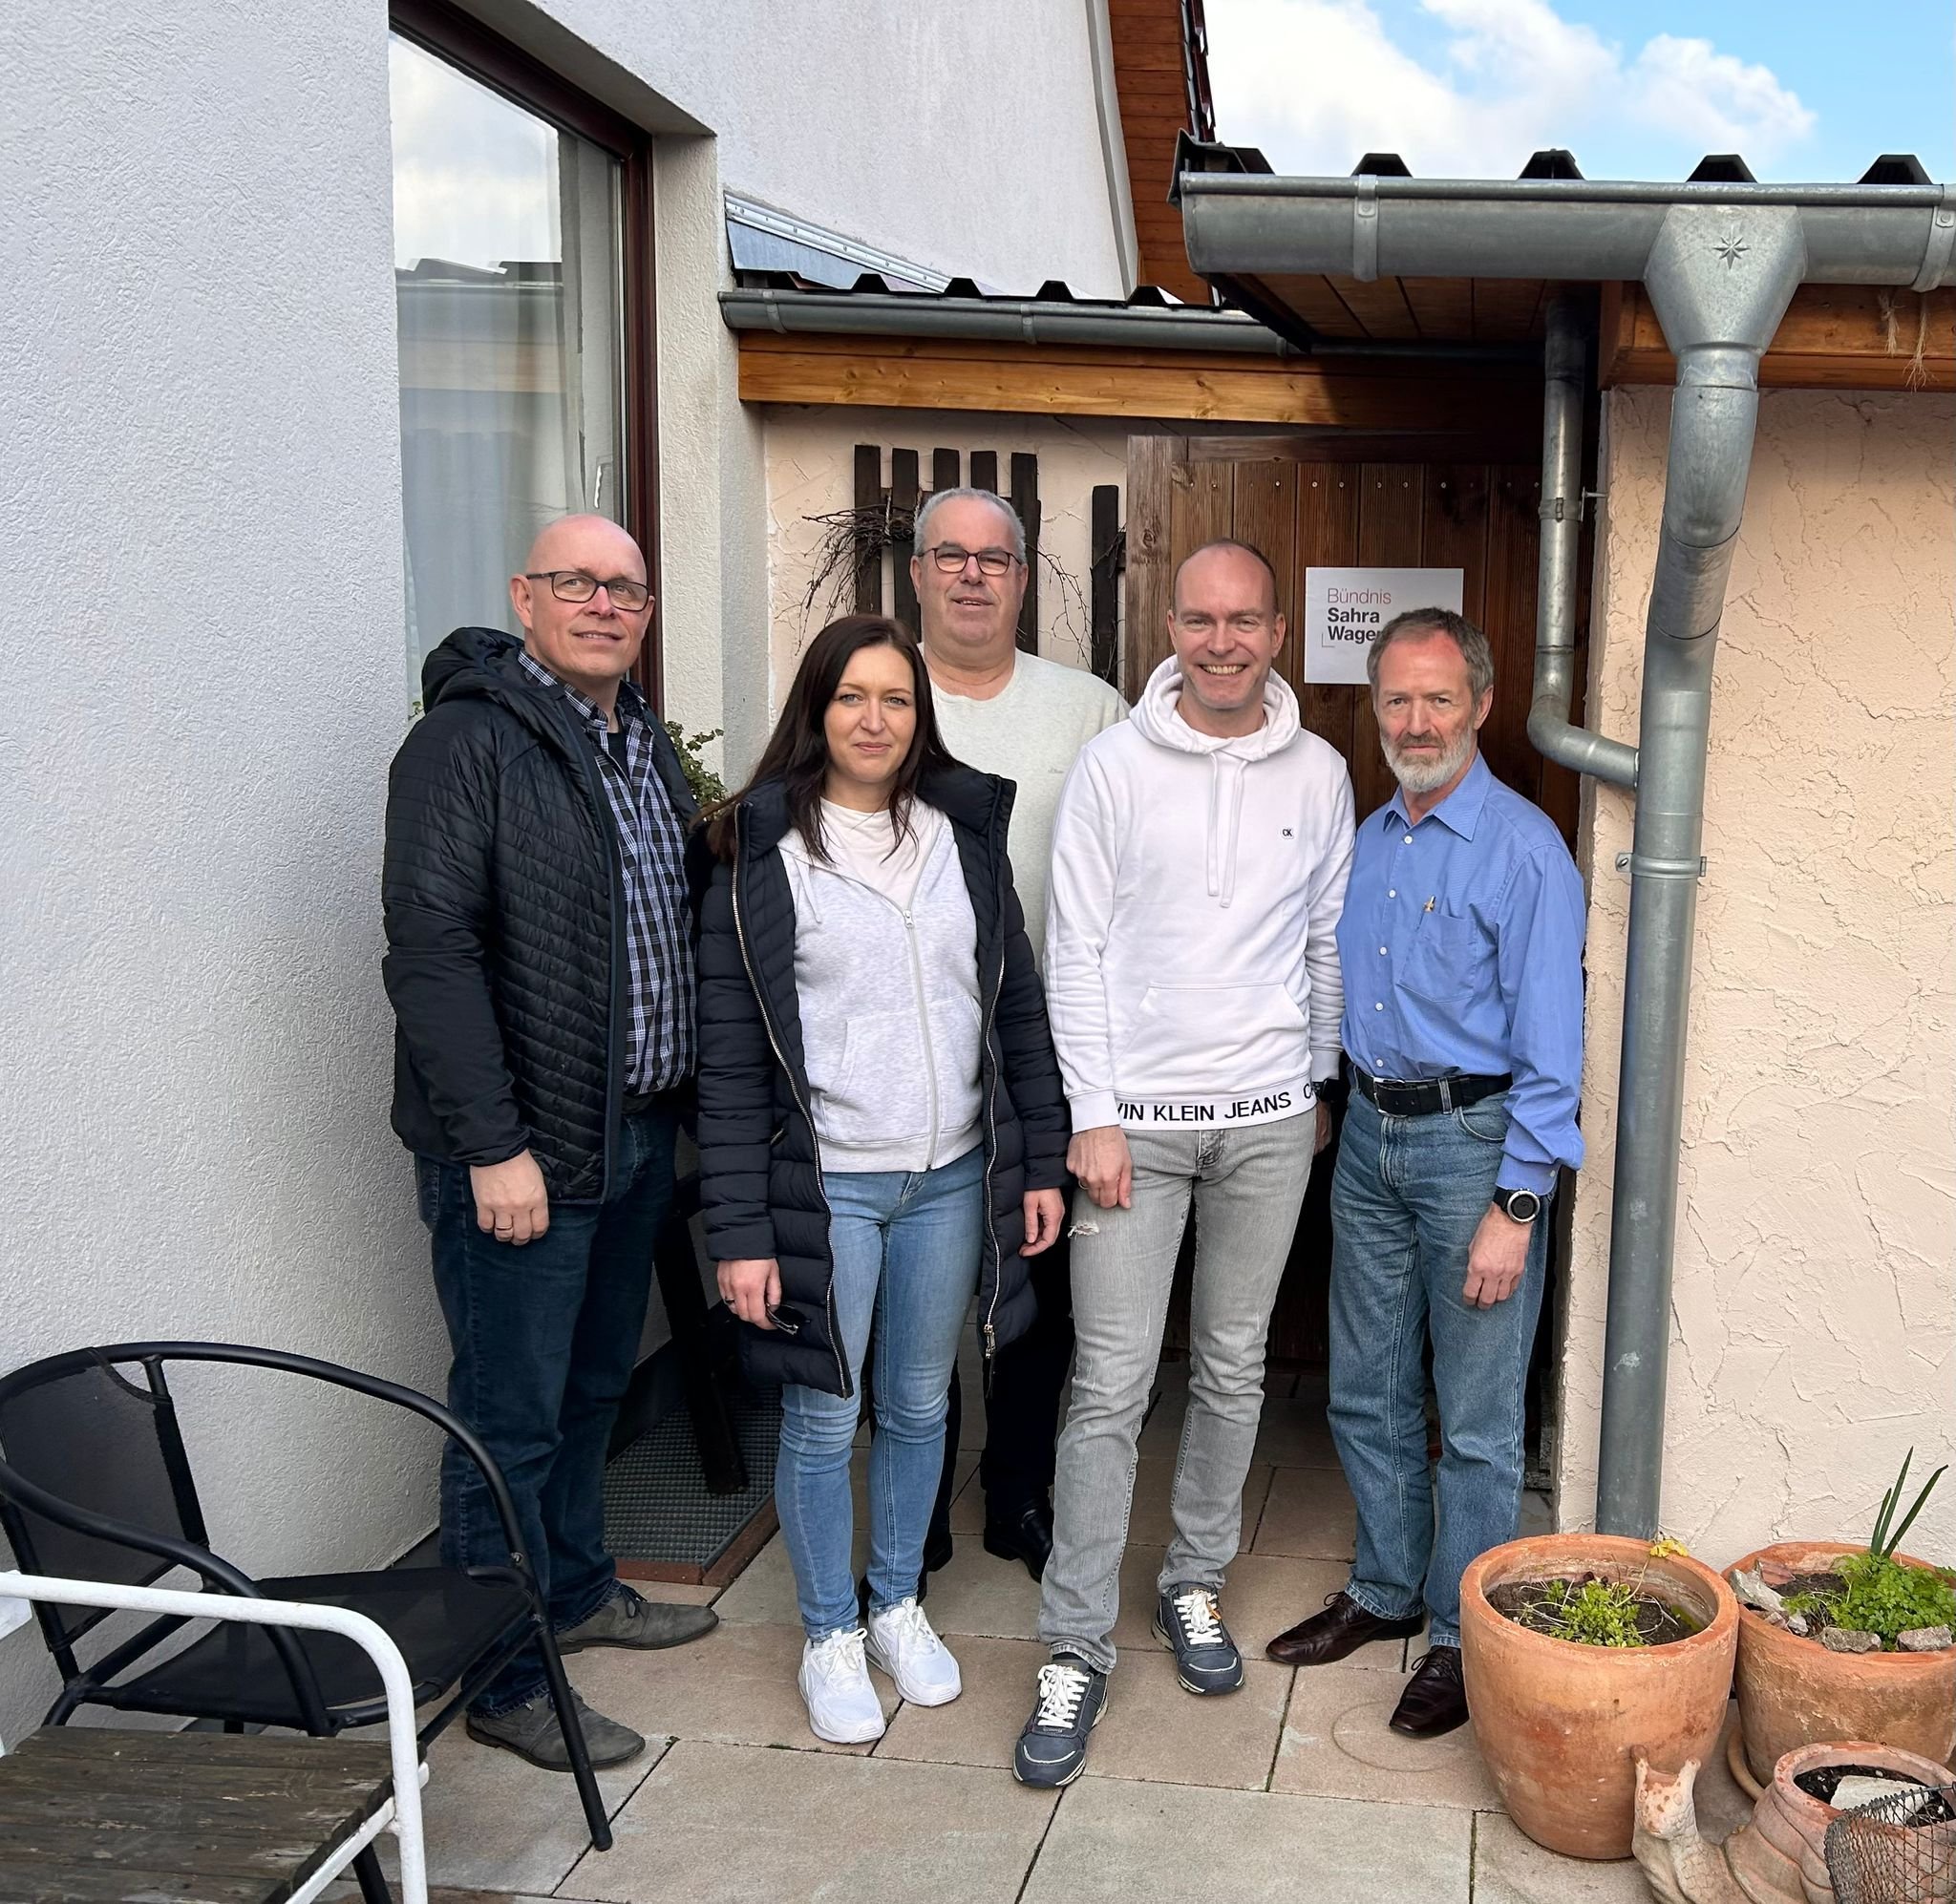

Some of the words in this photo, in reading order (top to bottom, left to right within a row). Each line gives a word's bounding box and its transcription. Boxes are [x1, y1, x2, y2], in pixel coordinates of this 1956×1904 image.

[1328, 587, 1392, 604] Bündnis
[1328, 607, 1380, 624] Sahra
[1154, 1105, 1215, 1122] KLEIN
[1224, 1091, 1292, 1119] JEANS
